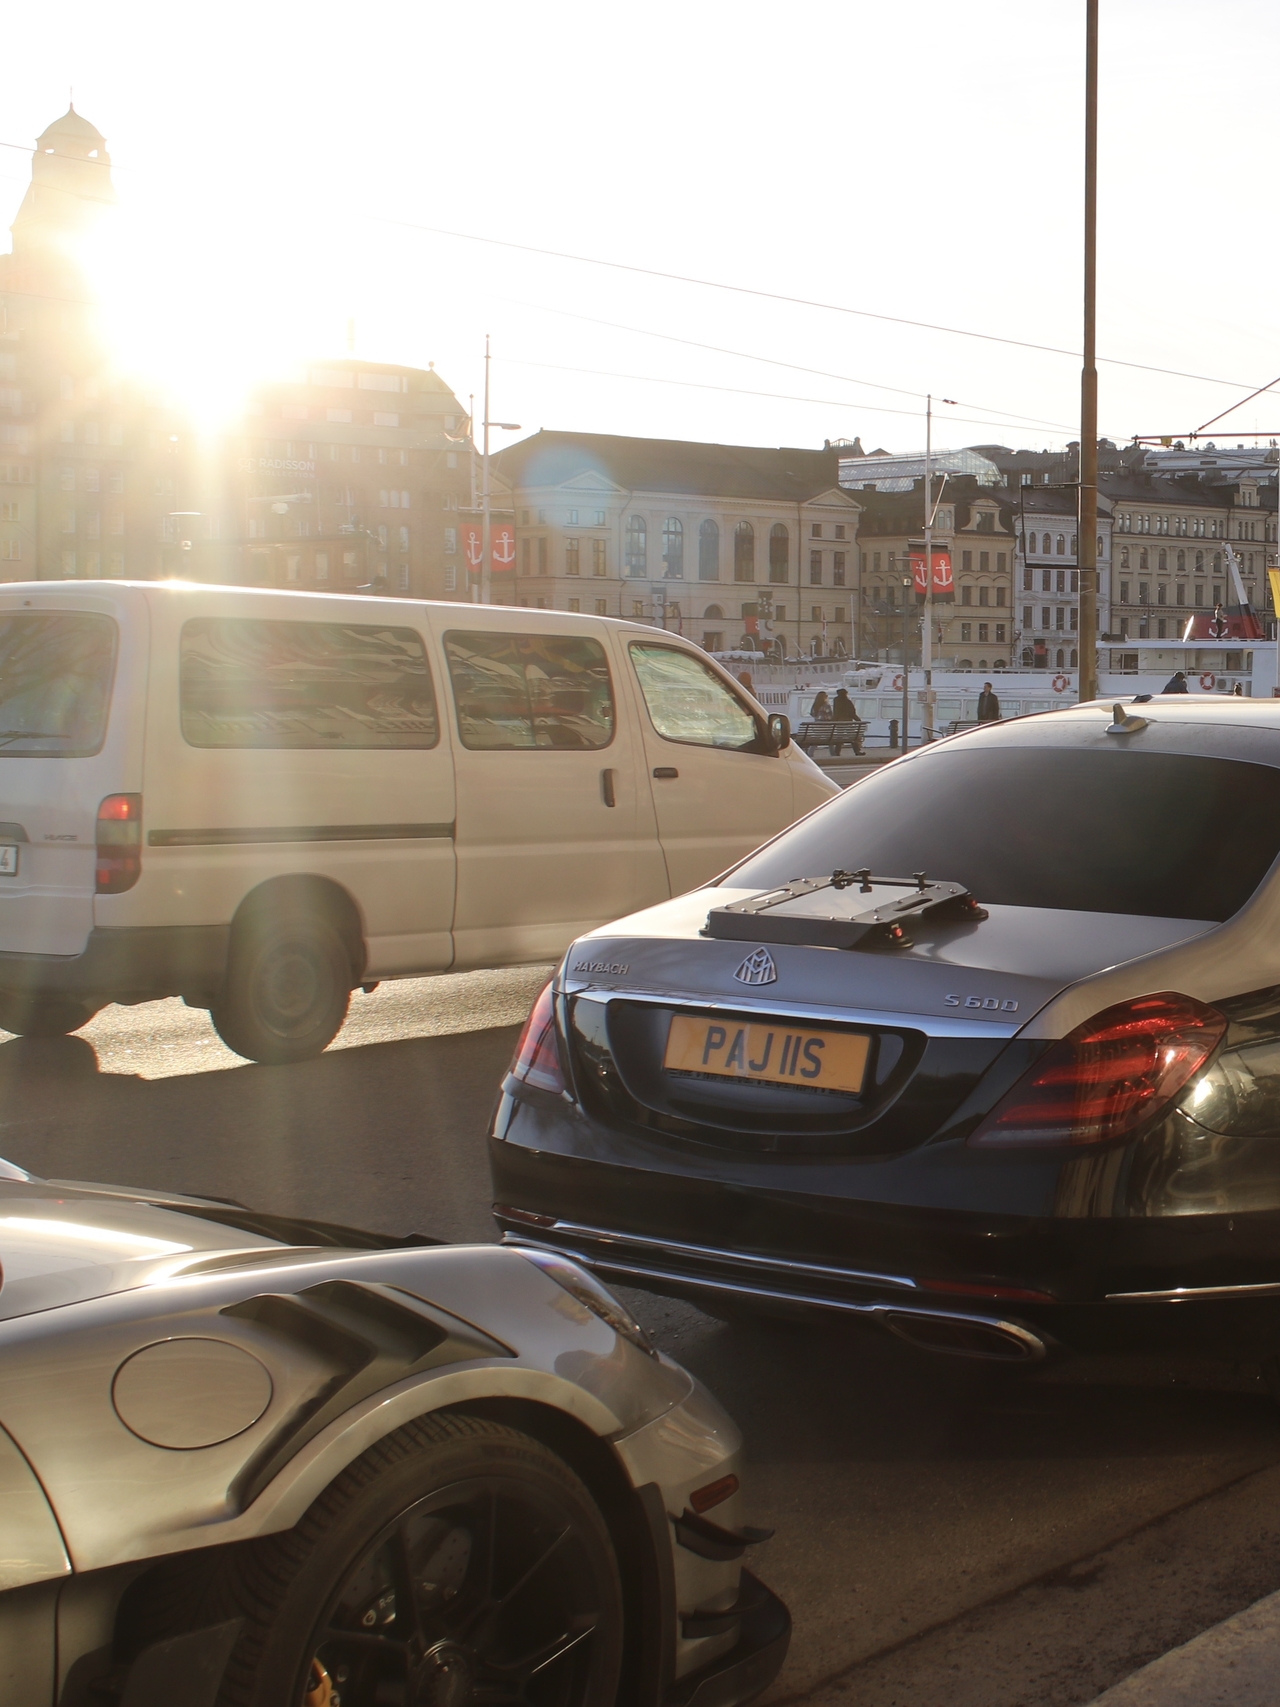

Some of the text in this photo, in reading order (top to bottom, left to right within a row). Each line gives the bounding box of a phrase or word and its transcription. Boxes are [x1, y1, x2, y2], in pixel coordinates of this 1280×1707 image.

[573, 961, 630, 975] MAYBACH
[943, 993, 1019, 1012] S 600
